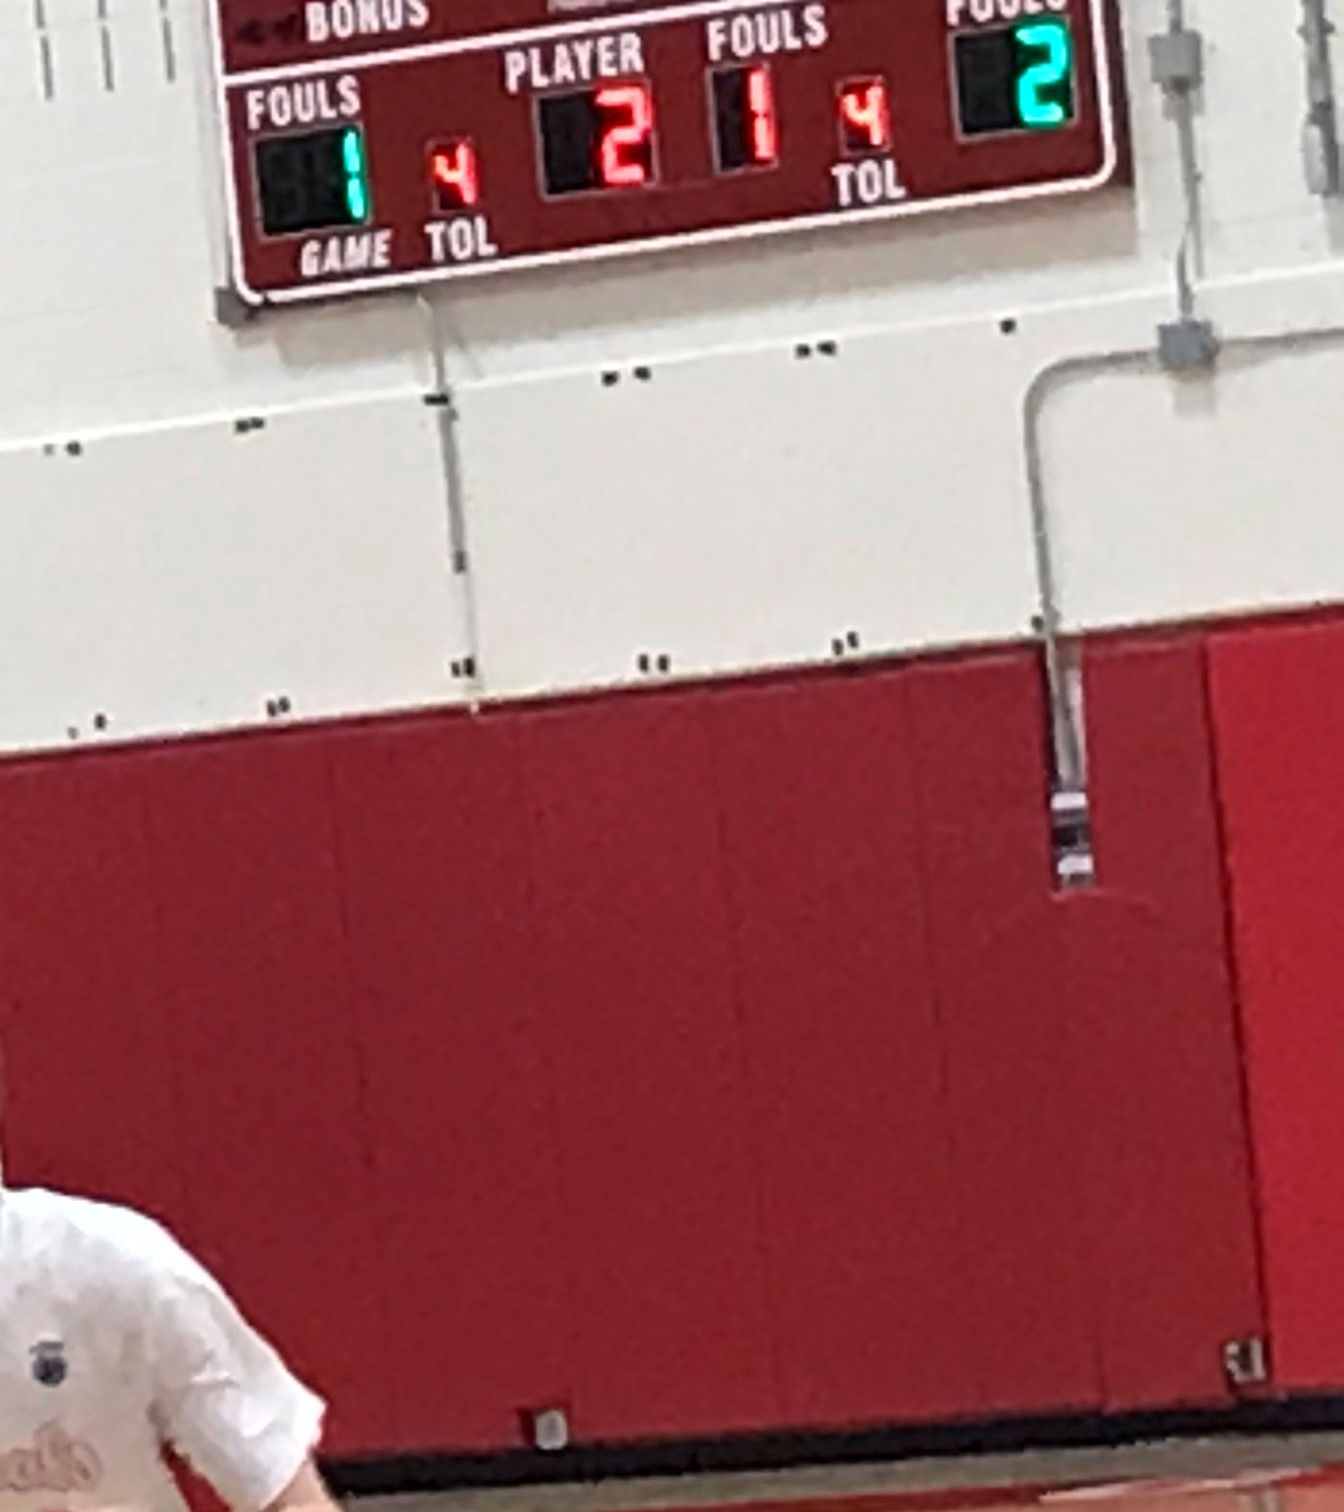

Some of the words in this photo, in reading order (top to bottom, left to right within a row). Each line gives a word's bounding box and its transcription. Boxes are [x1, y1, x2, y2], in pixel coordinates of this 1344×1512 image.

[304, 0, 430, 42] BONUS
[946, 0, 1068, 26] FOU
[504, 32, 645, 94] PLAYER
[707, 5, 829, 61] FOULS
[1016, 23, 1067, 124] 2
[246, 75, 361, 130] FOULS
[748, 69, 776, 160] 1
[841, 84, 885, 146] 4
[595, 86, 652, 184] 2
[341, 130, 365, 220] 1
[434, 140, 476, 205] 4
[830, 159, 907, 207] TOL
[301, 228, 393, 277] GAME
[424, 215, 498, 262] TOL
